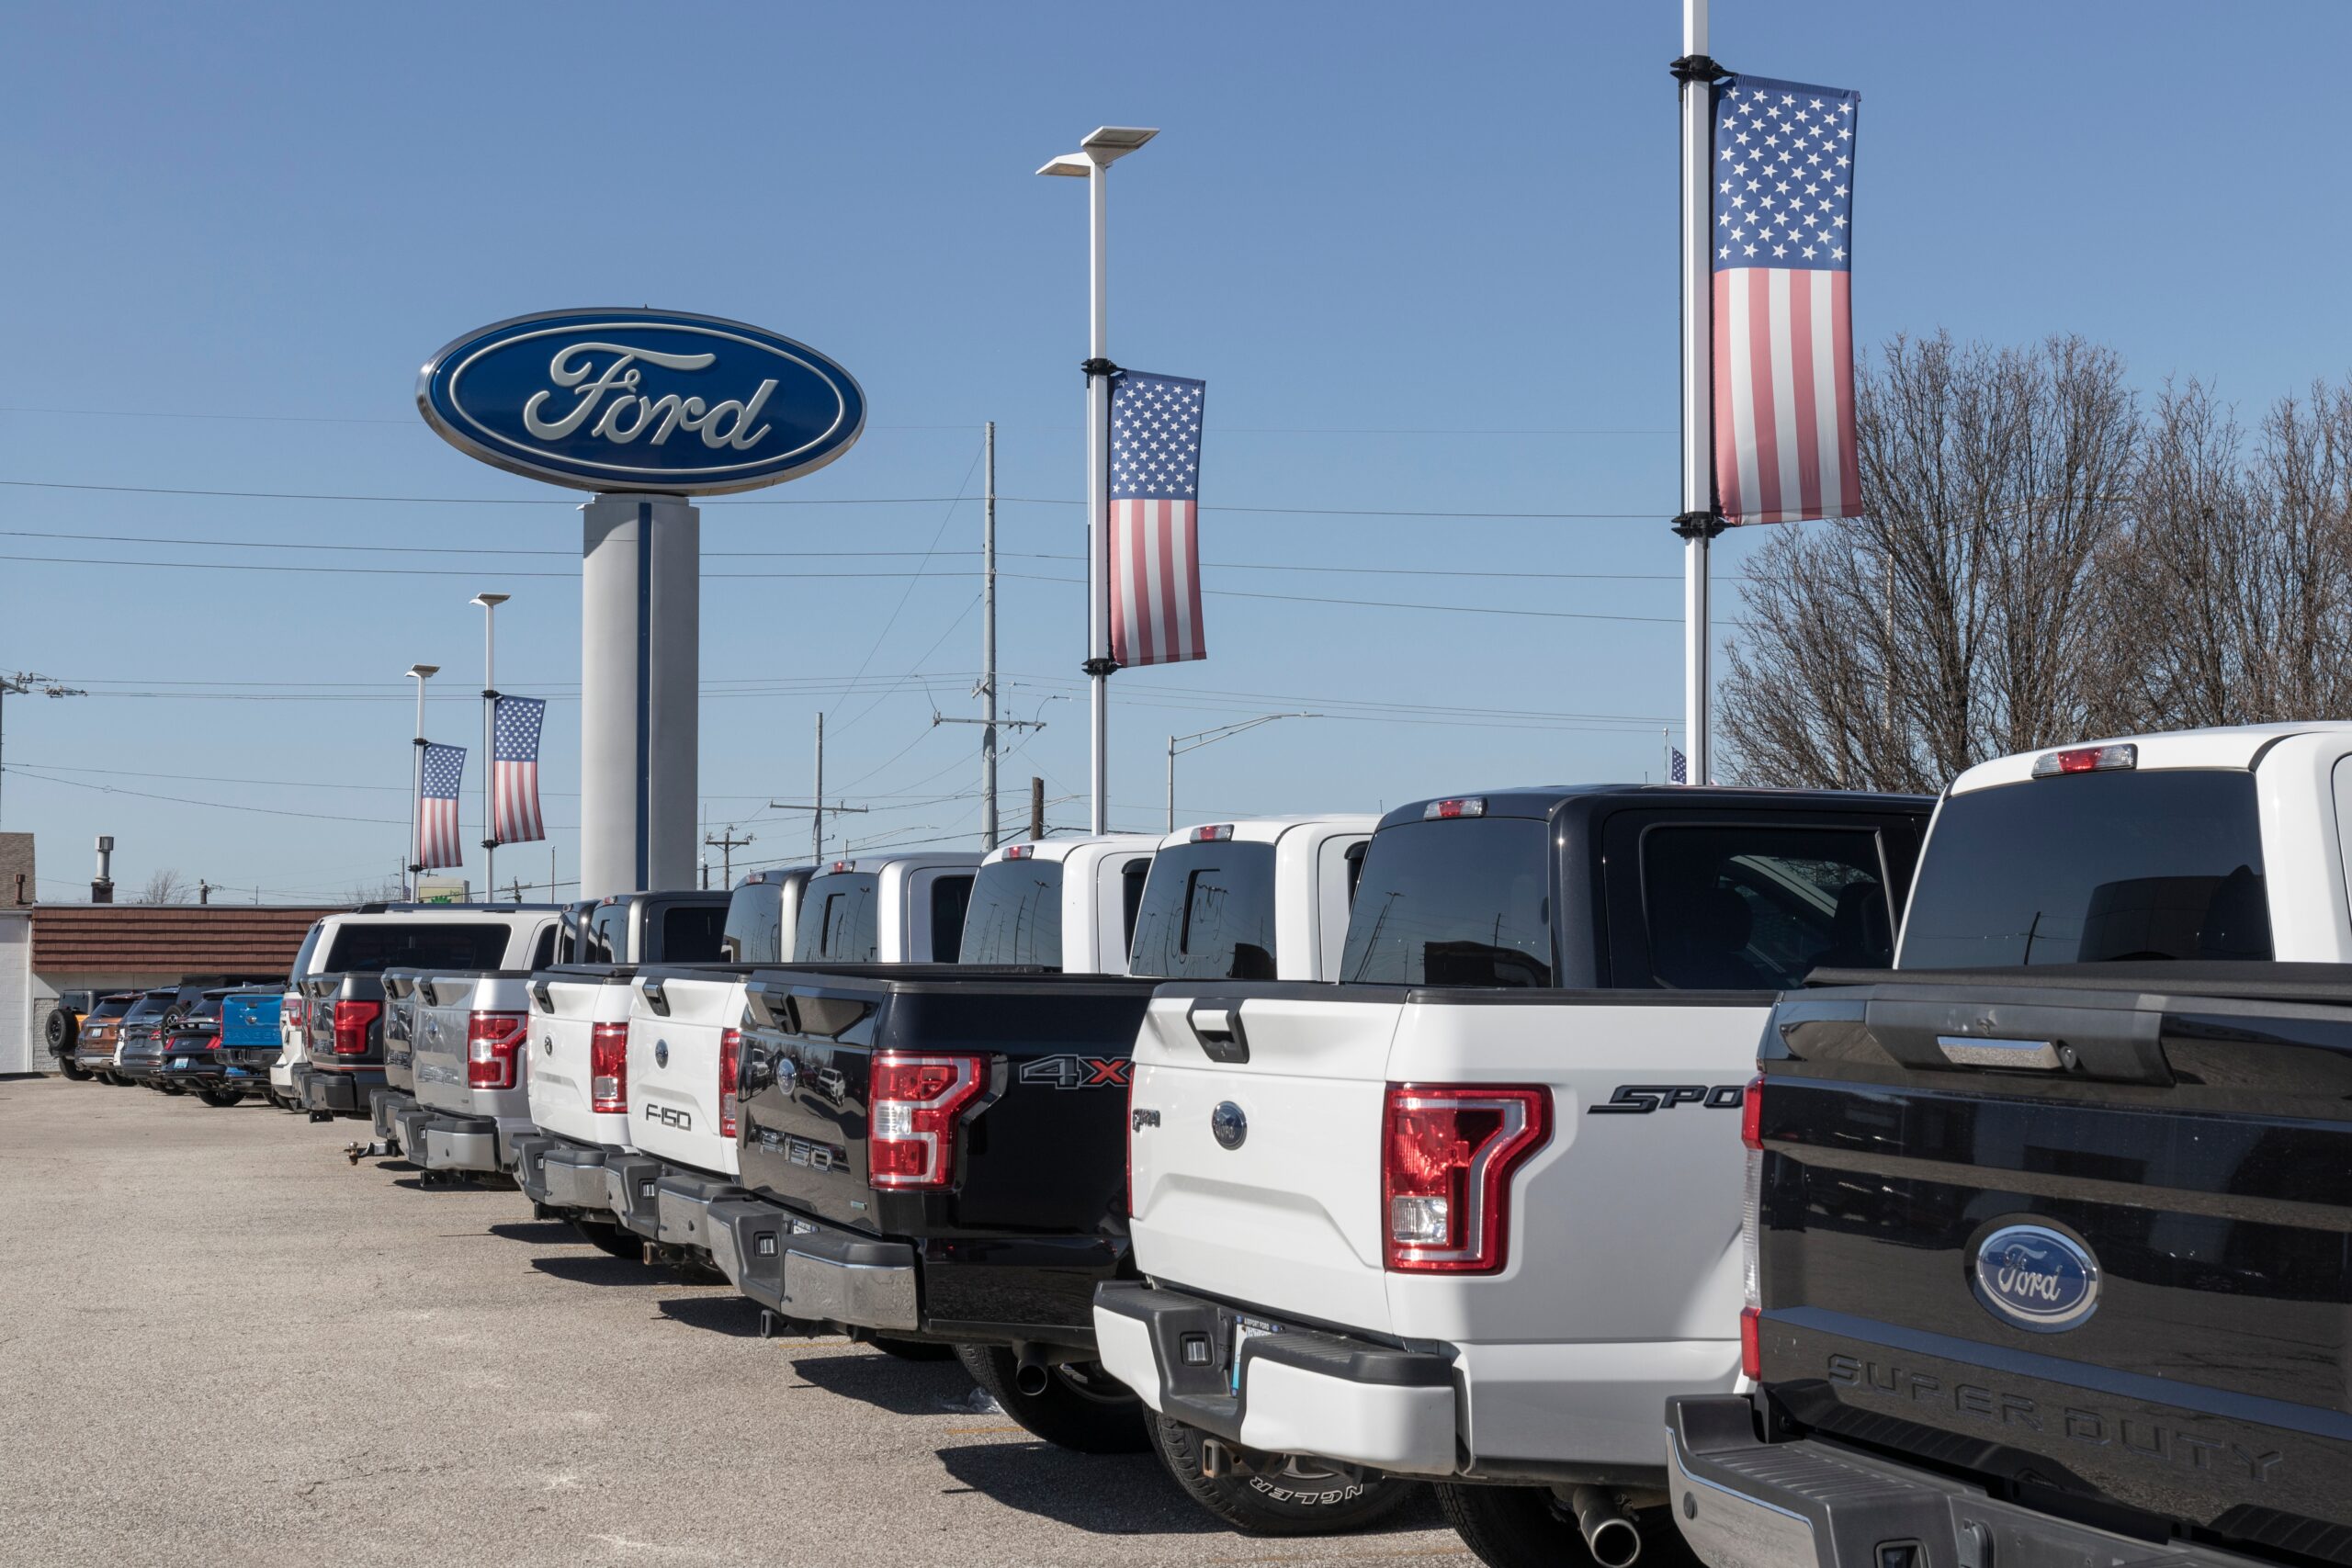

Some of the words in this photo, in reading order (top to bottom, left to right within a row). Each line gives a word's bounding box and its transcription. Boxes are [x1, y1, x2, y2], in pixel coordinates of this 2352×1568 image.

[523, 342, 780, 449] Ford
[1020, 1054, 1133, 1089] 4X
[1587, 1085, 1744, 1114] SPO
[646, 1103, 691, 1132] F-150
[1998, 1244, 2064, 1301] Ford
[1260, 1321, 1270, 1331] FORD
[1828, 1353, 2043, 1432] SUPER
[2064, 1407, 2283, 1482] DUTY
[1250, 1475, 1363, 1505] NGLER
